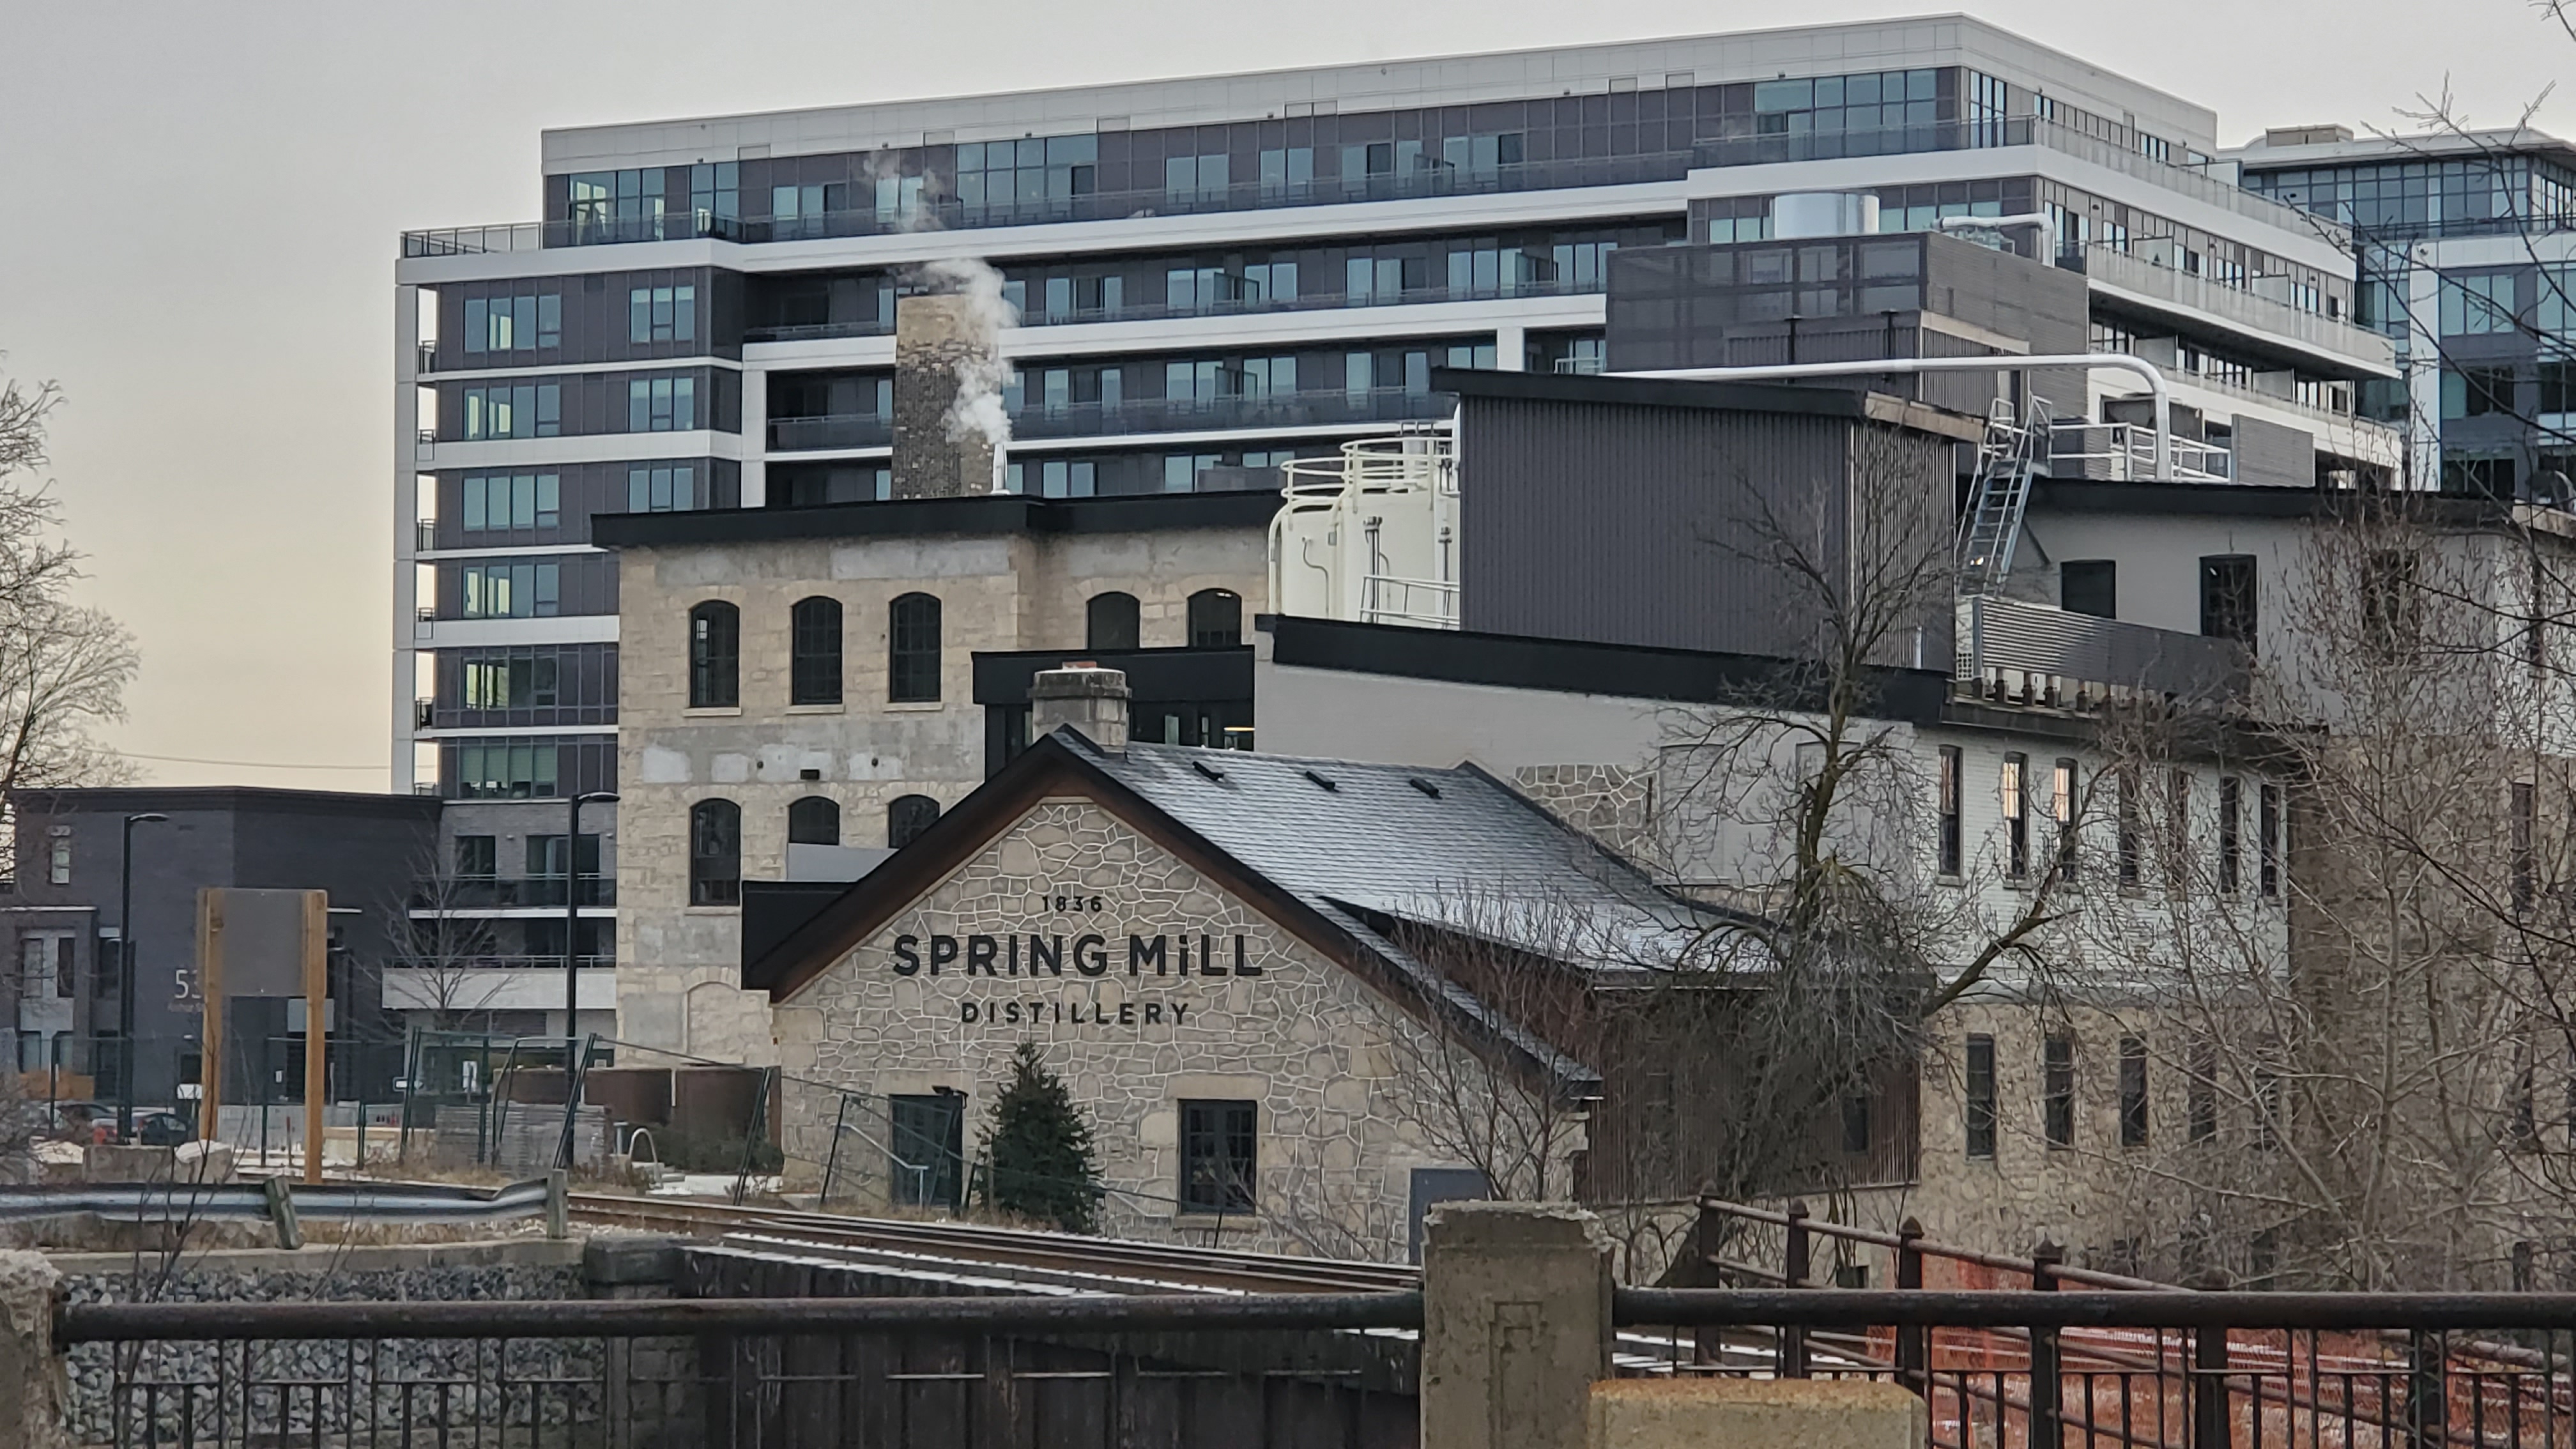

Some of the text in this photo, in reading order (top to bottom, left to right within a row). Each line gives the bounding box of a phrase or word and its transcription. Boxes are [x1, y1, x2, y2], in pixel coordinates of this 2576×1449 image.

[1042, 896, 1102, 912] 1836
[894, 935, 1108, 976] SPRING
[962, 1002, 1189, 1025] DISTILLERY
